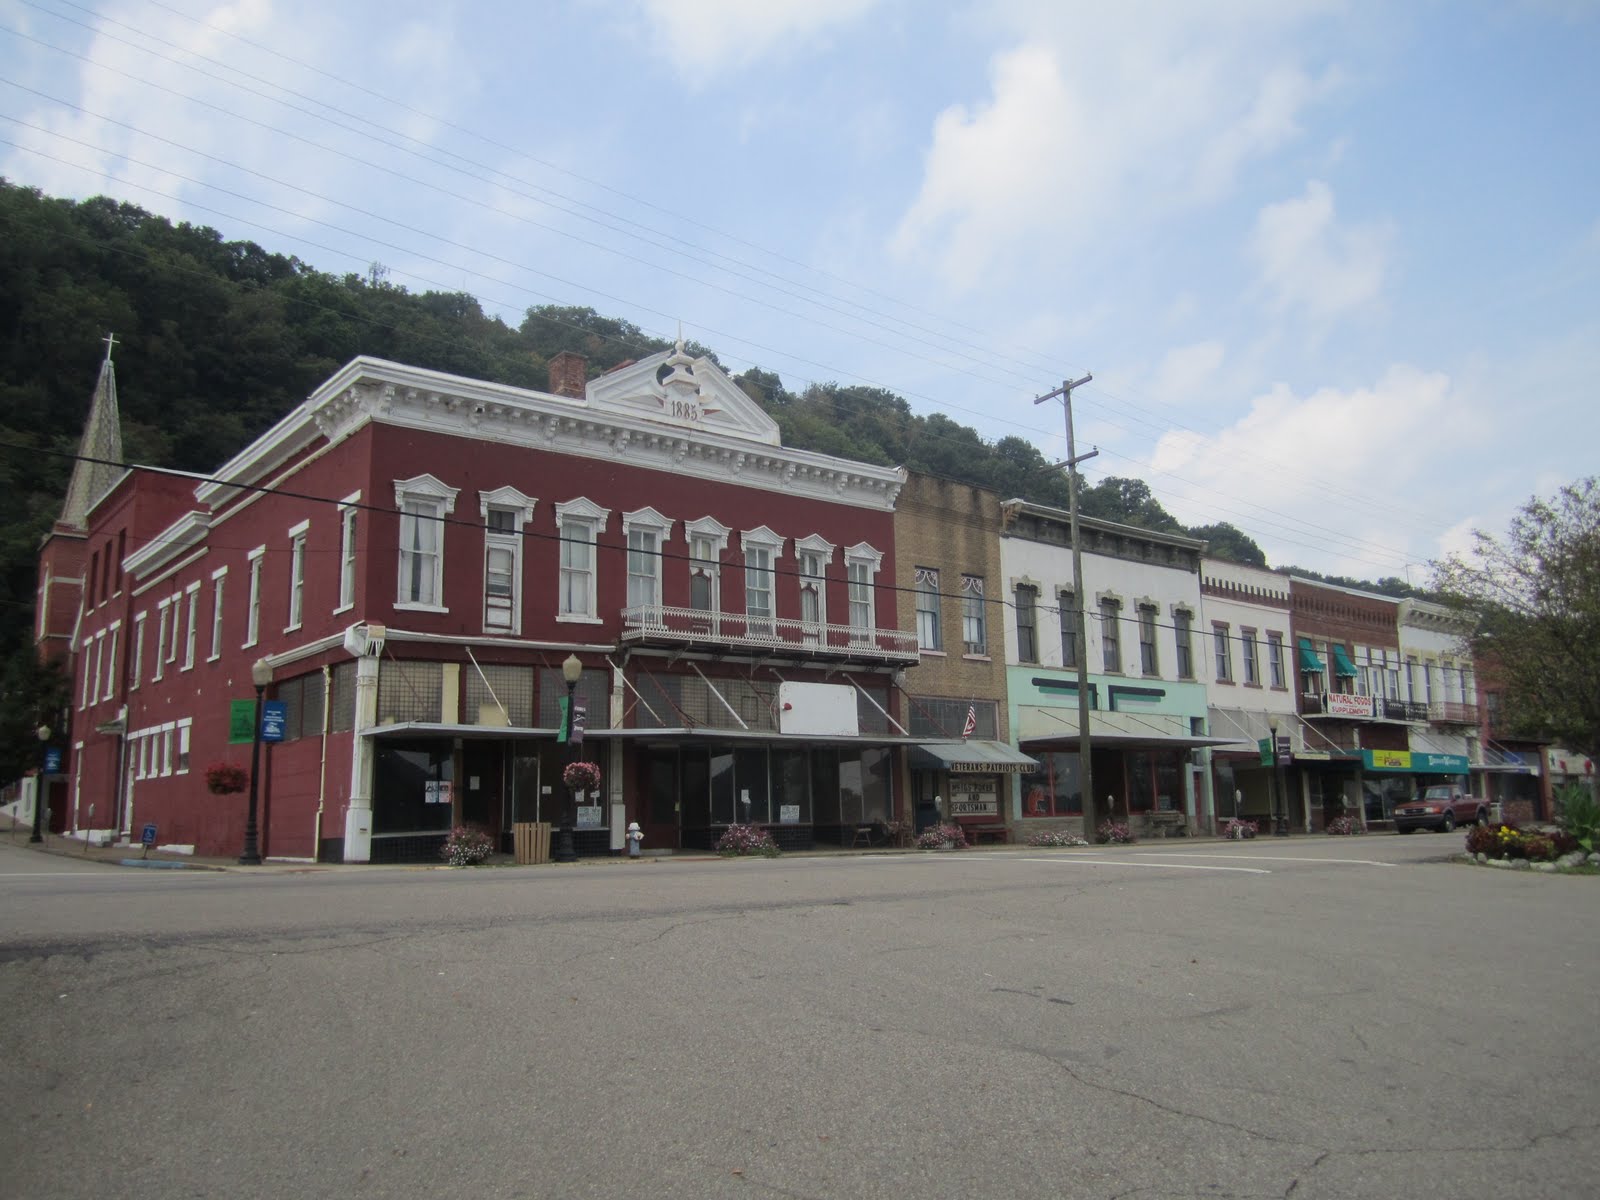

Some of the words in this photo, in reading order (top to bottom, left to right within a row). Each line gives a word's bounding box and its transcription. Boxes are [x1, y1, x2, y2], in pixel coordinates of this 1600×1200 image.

[671, 400, 698, 421] 1885
[1328, 694, 1353, 704] NATURAL
[951, 762, 983, 771] VETERANS
[986, 763, 1017, 772] PATRIOTS
[1019, 764, 1035, 772] CLUB
[968, 793, 980, 801] AND
[951, 803, 987, 812] SPORTSMAN
